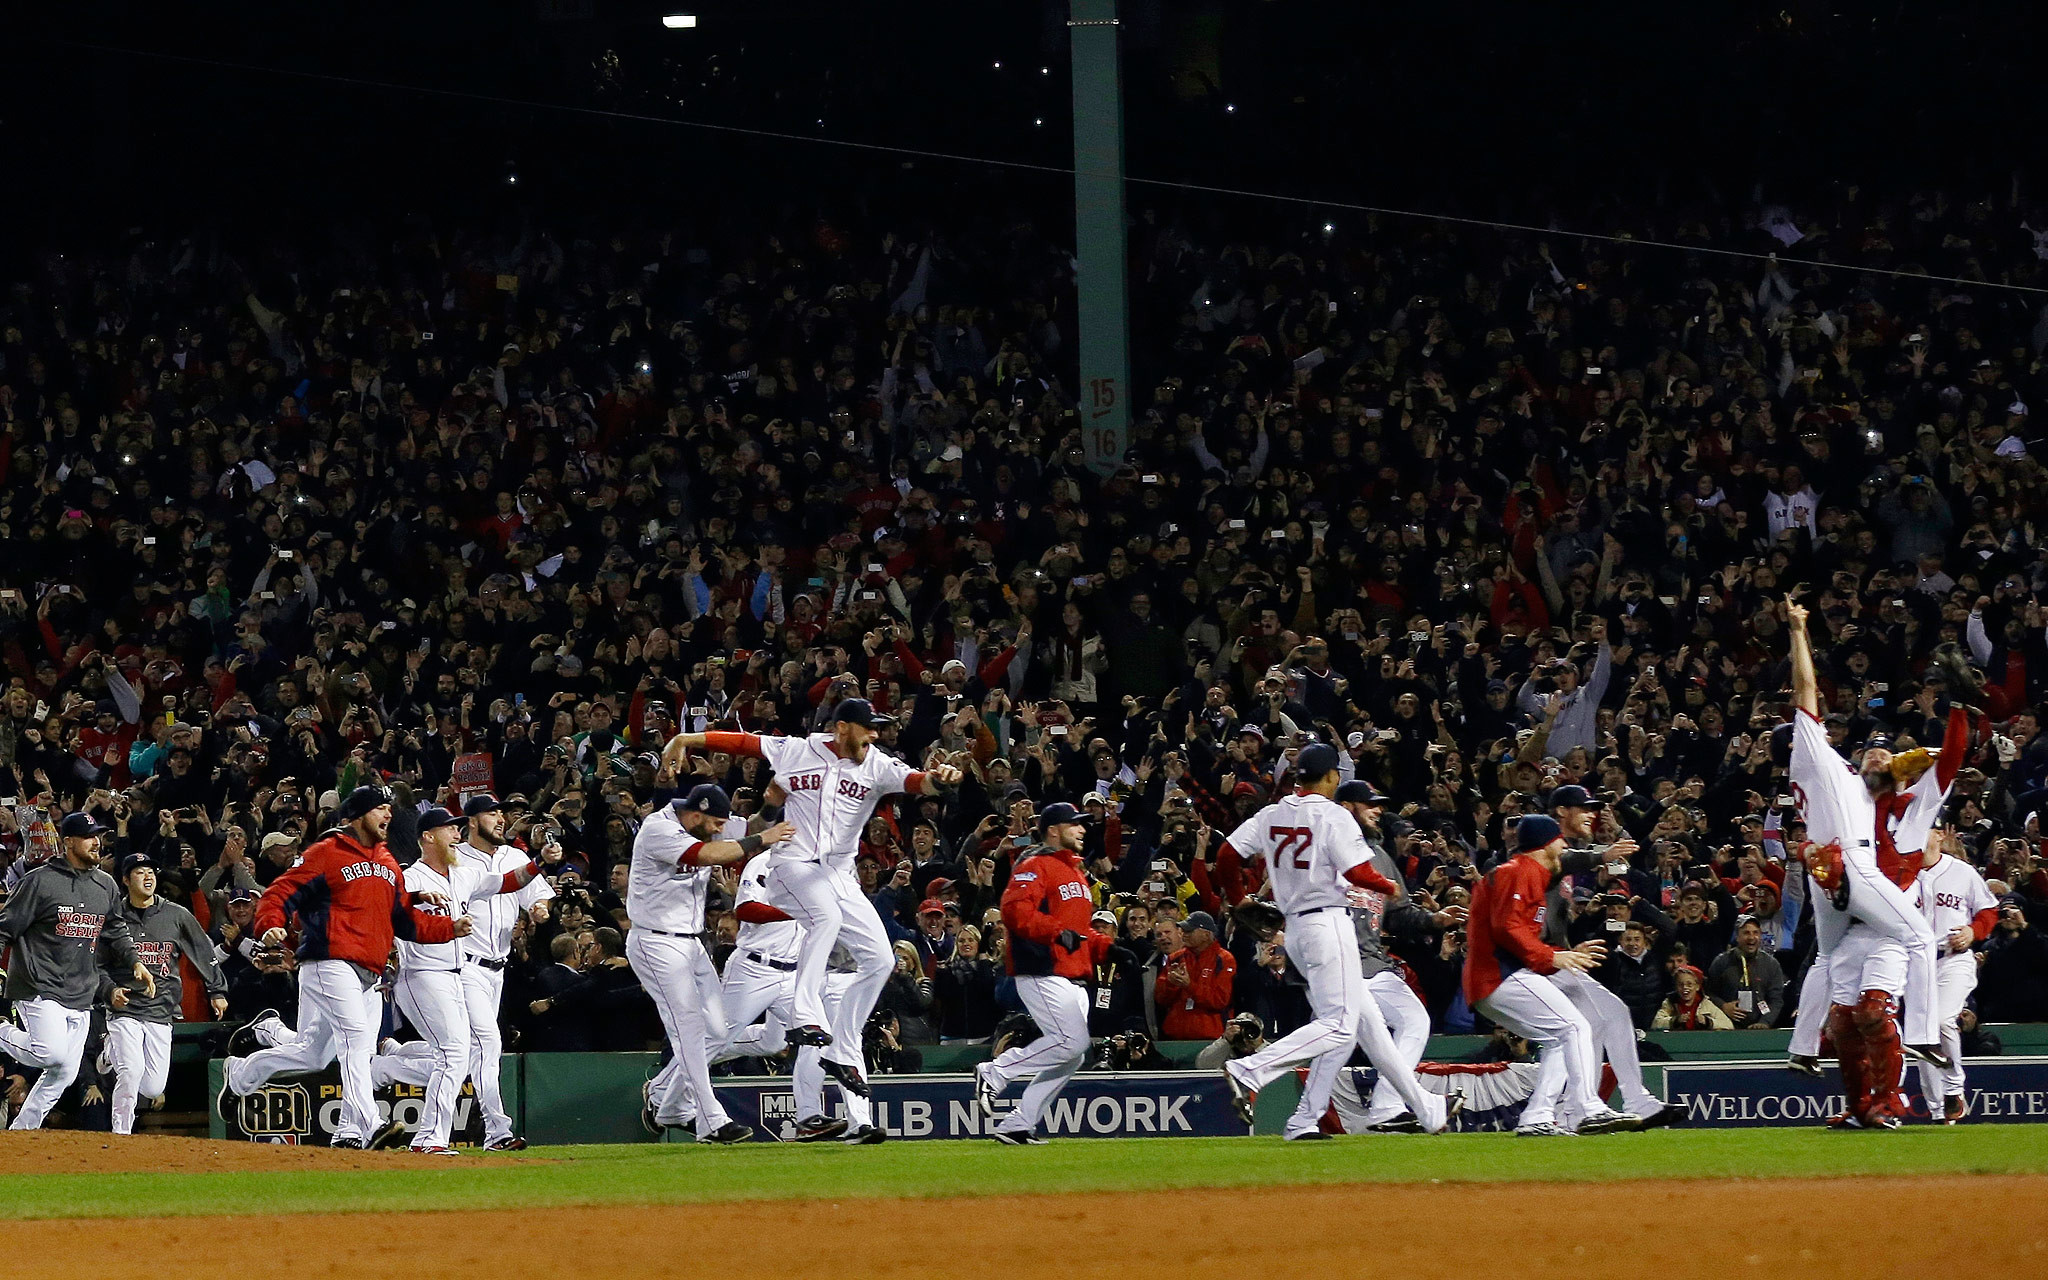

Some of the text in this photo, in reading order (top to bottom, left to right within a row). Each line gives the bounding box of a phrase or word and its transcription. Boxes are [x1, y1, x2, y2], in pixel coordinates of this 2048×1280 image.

[1090, 379, 1115, 407] 15
[1093, 429, 1116, 456] 16
[789, 774, 871, 800] RED SOX
[1270, 826, 1313, 869] 72
[341, 862, 373, 882] RED
[1058, 881, 1083, 901] RED
[1936, 892, 1963, 910] SOX
[57, 905, 74, 913] 2013
[57, 912, 106, 926] WORLD
[395, 1083, 474, 1097] LEN
[242, 1088, 307, 1132] RBI
[764, 1096, 797, 1112] ML
[1958, 1088, 2048, 1117] VETE
[949, 1095, 1193, 1136] NEWORK
